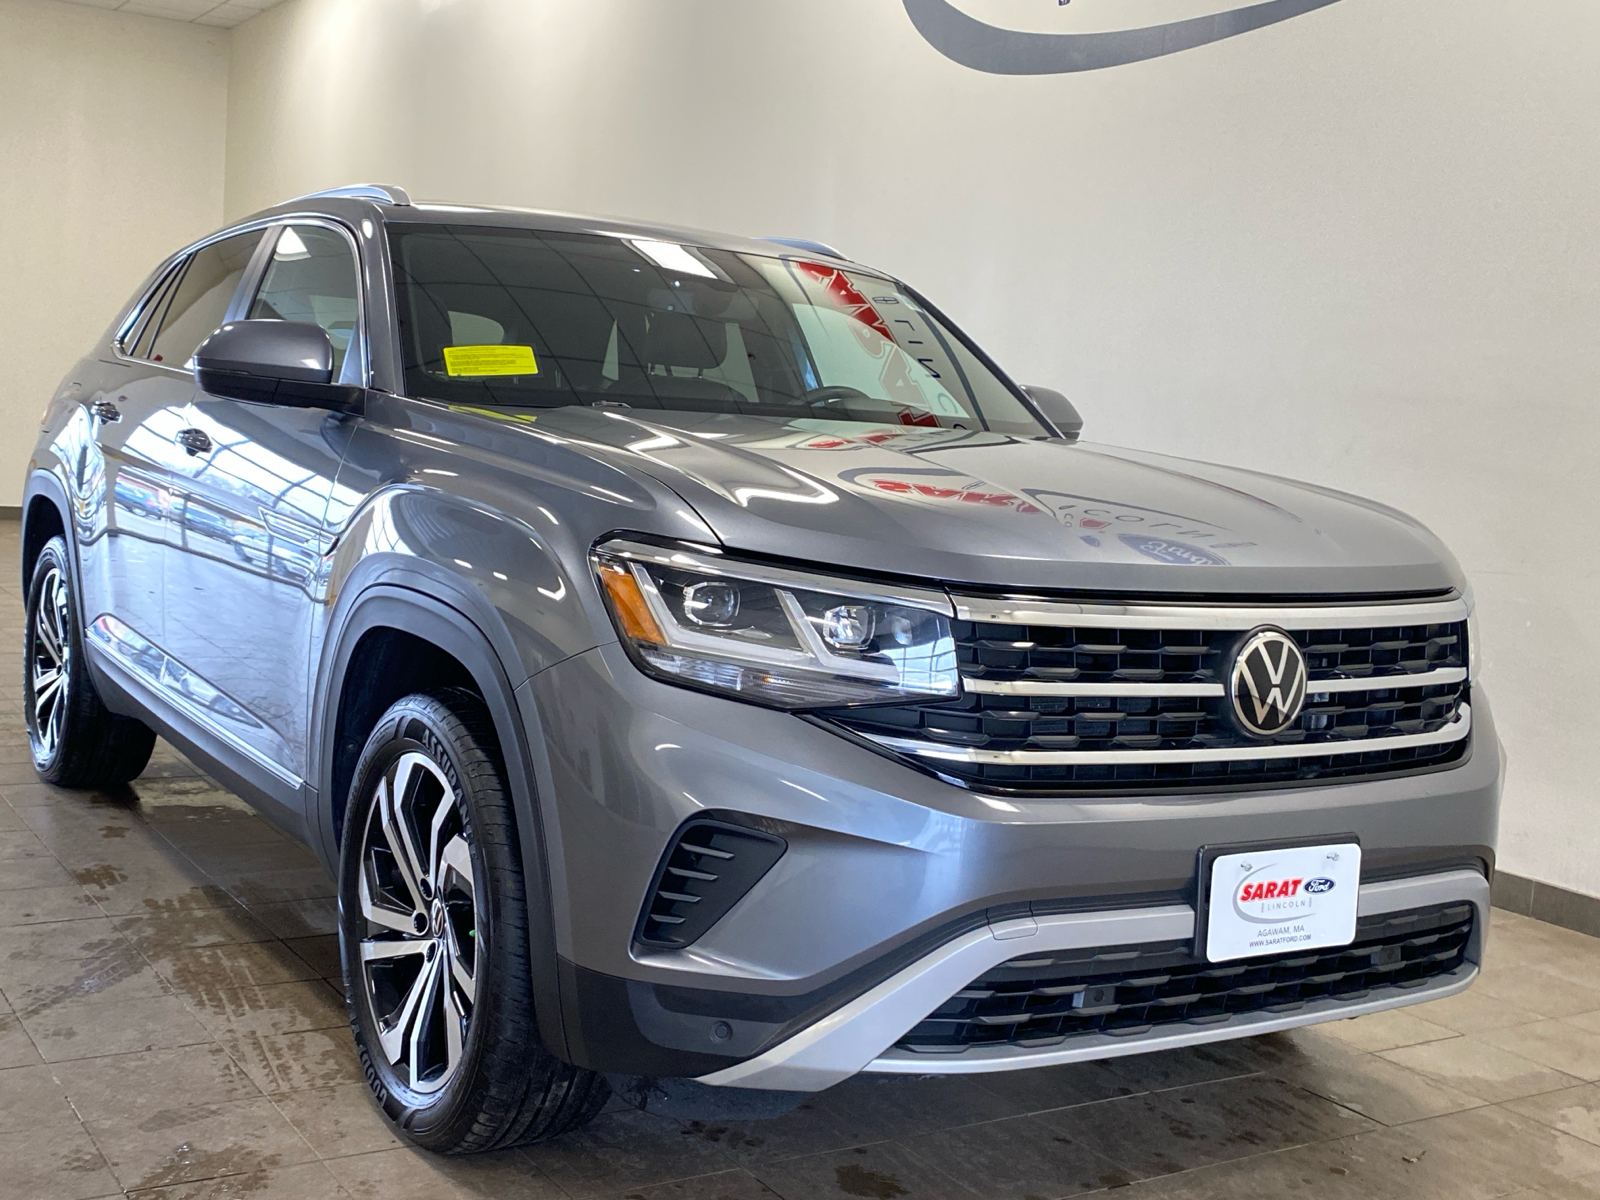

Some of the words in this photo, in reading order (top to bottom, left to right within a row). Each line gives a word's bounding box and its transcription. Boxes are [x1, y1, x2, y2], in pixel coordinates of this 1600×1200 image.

[1240, 877, 1303, 902] SARAT
[1307, 878, 1332, 894] Ford
[1267, 900, 1306, 910] LINCOLN
[1257, 926, 1292, 938] AGAWAM,
[1293, 924, 1305, 934] MA
[1248, 934, 1312, 948] WWW.SARATFORD.COM
